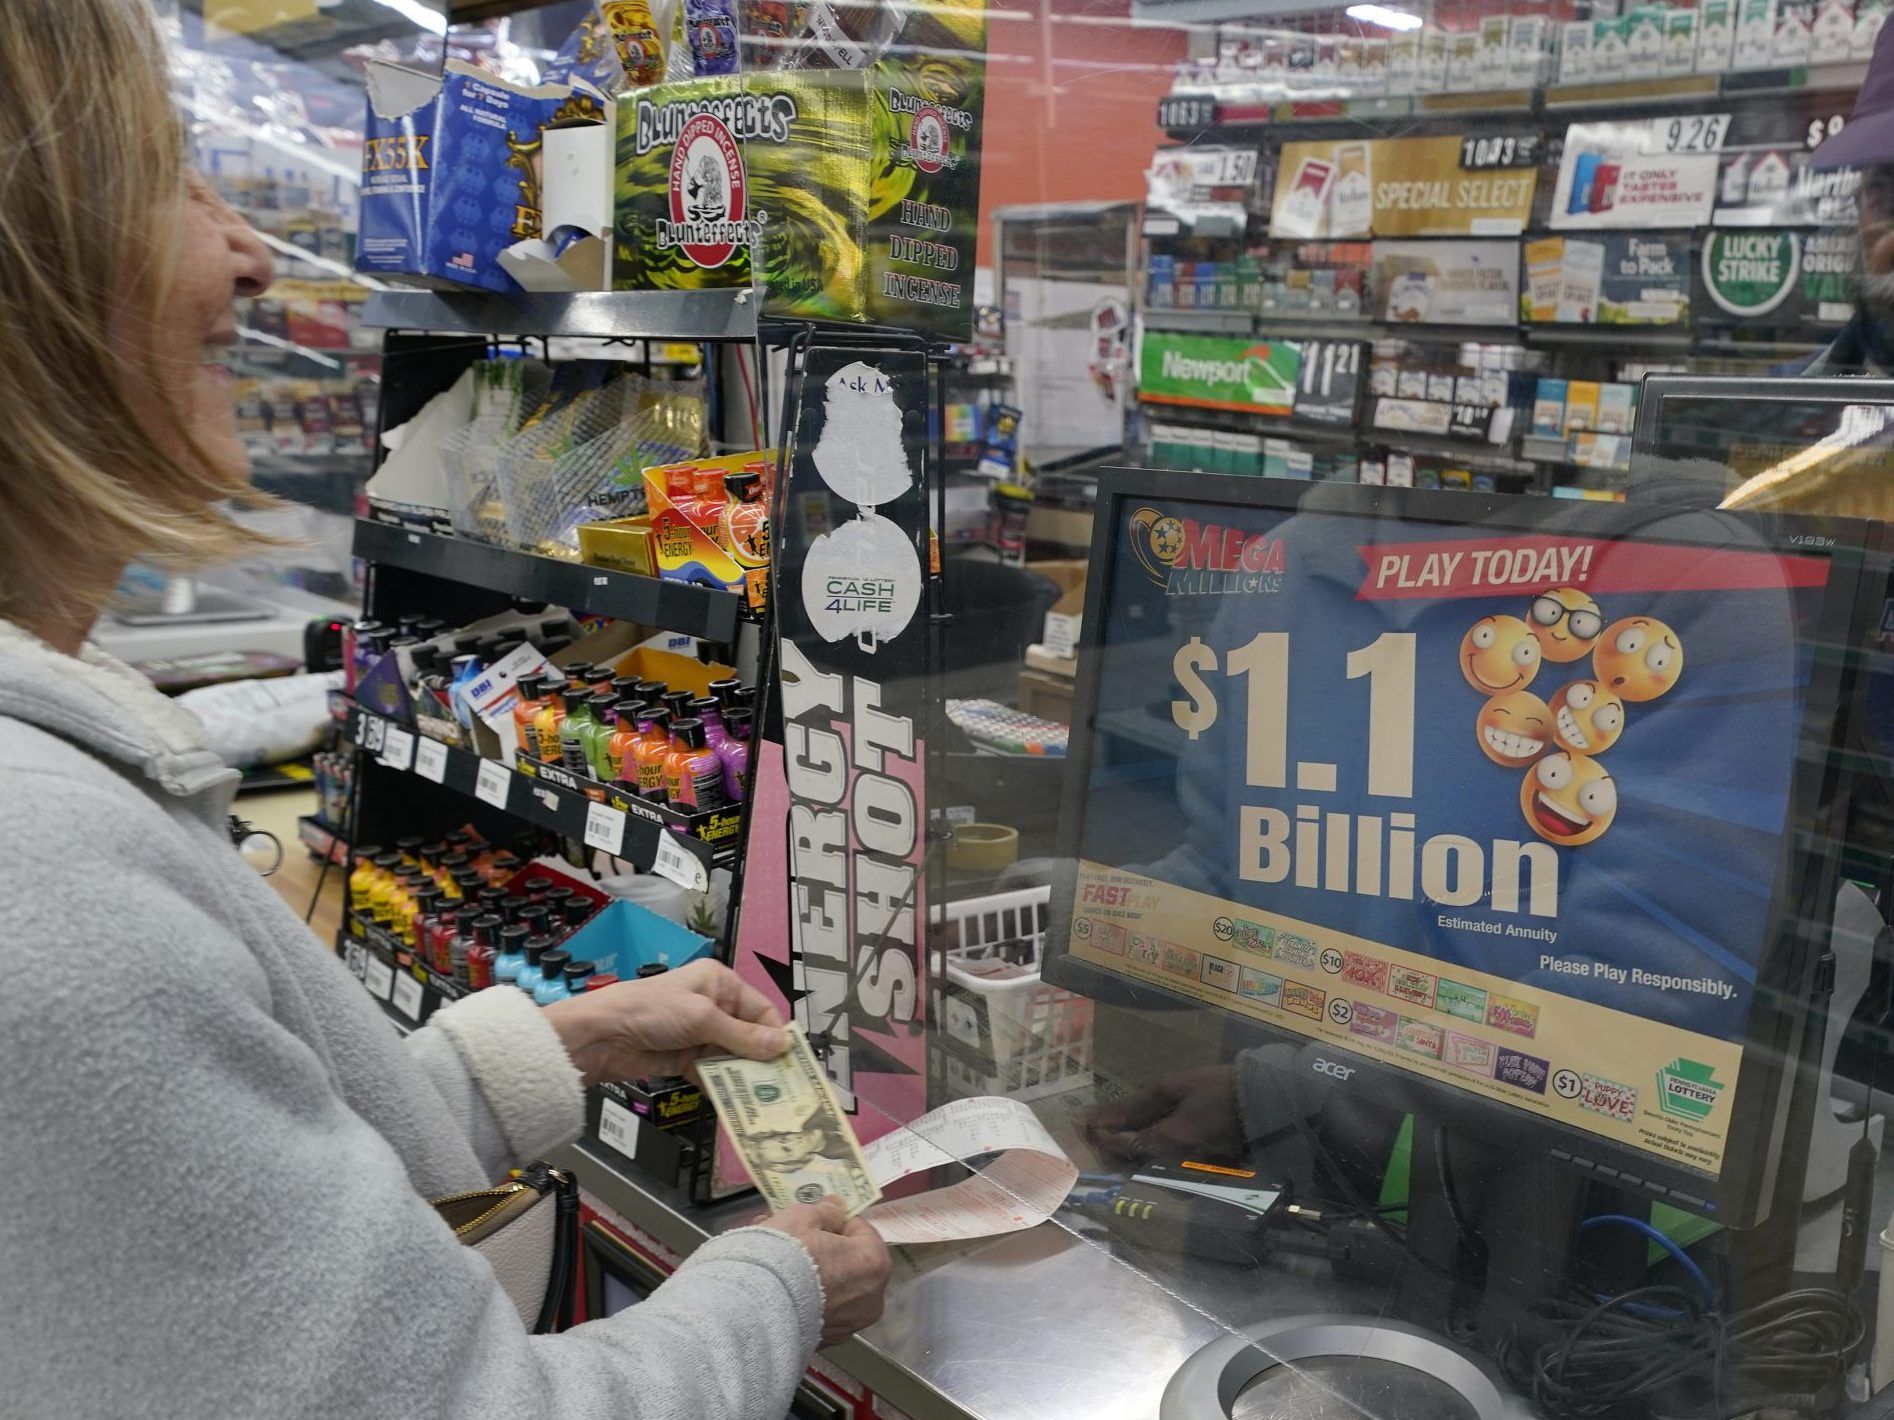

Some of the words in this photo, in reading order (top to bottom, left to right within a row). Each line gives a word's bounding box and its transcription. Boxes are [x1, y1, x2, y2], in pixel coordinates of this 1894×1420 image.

[671, 147, 687, 192] HAND
[683, 119, 715, 147] DIPPED
[714, 128, 741, 189] INCENSE
[1376, 181, 1451, 210] SPECIAL
[1456, 178, 1530, 209] SELECT
[901, 199, 952, 232] HAND
[890, 235, 959, 271] DIPPED
[1723, 234, 1782, 259] LUCKY
[1718, 259, 1781, 283] STRIKE
[883, 272, 961, 308] INCENSE
[1162, 350, 1250, 387] Newport
[664, 540, 694, 558] ENERGY
[1173, 519, 1286, 575] MEGA
[1376, 551, 1464, 589] PLAY
[1470, 546, 1594, 585] TODAY!
[827, 580, 894, 597] CASH
[1166, 571, 1283, 596] MILLIONS
[824, 598, 893, 614] 4LIFE
[668, 636, 690, 648] DBI
[470, 679, 493, 698] DBI
[1171, 631, 1417, 799] $1.1
[539, 766, 578, 790] EXTRA
[631, 804, 664, 824] EXTRA
[853, 676, 916, 1022] SHOT
[1239, 804, 1561, 919] Billion
[1082, 883, 1132, 907] FAST
[1076, 921, 1089, 935] $5
[1214, 922, 1233, 936] $20
[1437, 915, 1503, 936] Estimated
[1505, 922, 1558, 944] Annuity
[1322, 953, 1342, 968] $10
[1539, 955, 1591, 977] Please
[1593, 963, 1628, 985] Play
[1632, 968, 1738, 999] Responsibly.
[1333, 1004, 1348, 1019] $2
[1312, 1057, 1356, 1081] acer
[1558, 1075, 1575, 1092] $1
[1594, 1081, 1624, 1097] PUPPY
[1668, 1083, 1716, 1104] LOTTERY
[1583, 1090, 1629, 1115] LOVE
